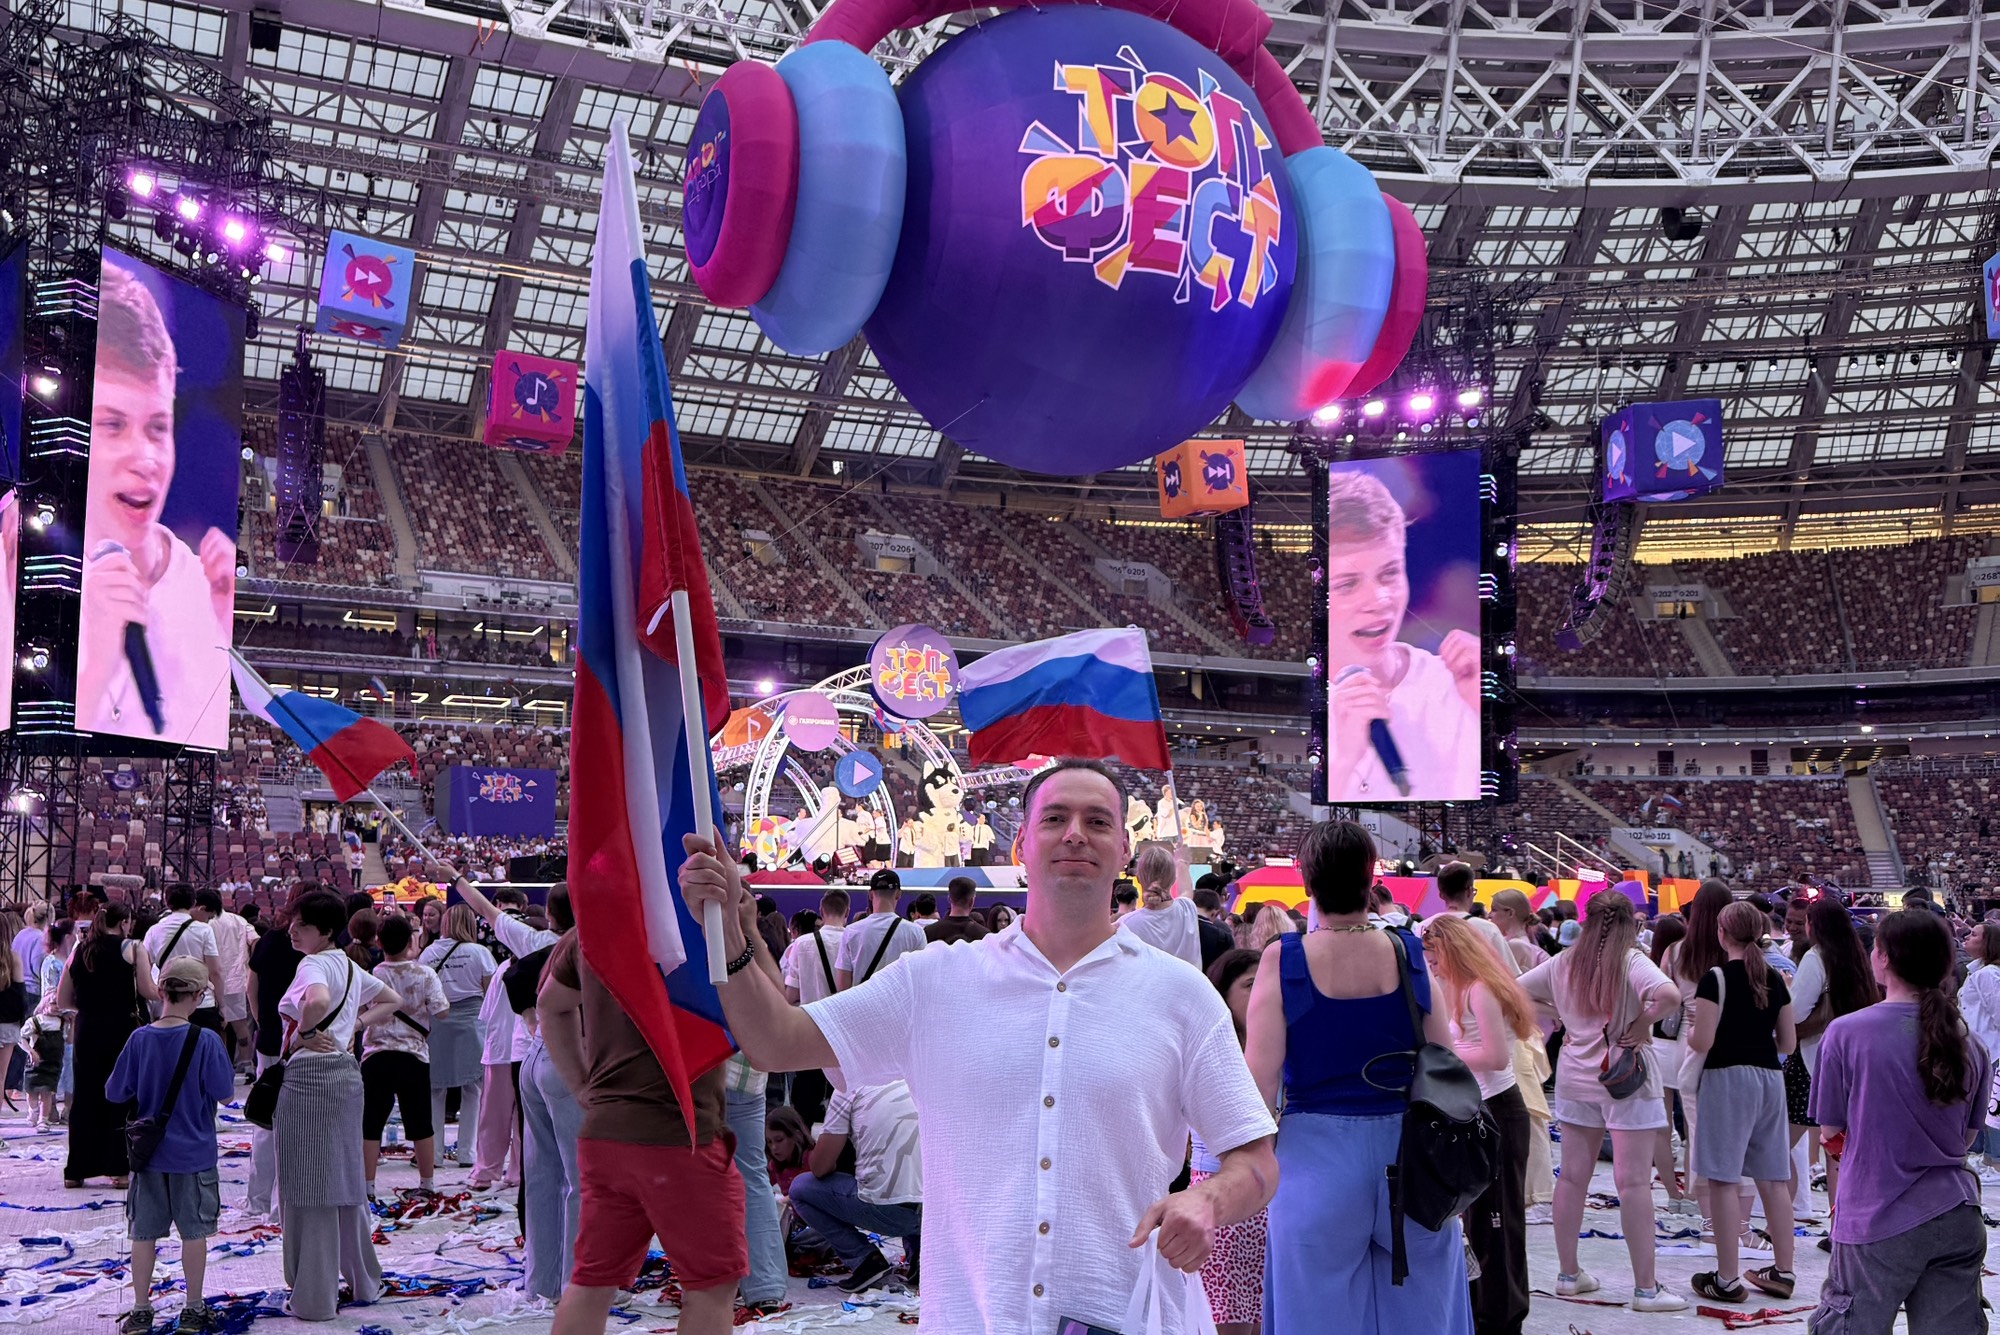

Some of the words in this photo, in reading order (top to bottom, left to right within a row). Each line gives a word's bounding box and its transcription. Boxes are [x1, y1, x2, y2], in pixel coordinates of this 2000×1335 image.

[1054, 63, 1265, 191] ТОП
[1022, 154, 1281, 308] ФЕСТ
[879, 668, 951, 699] ФЕСТ
[886, 647, 942, 673] ТОП
